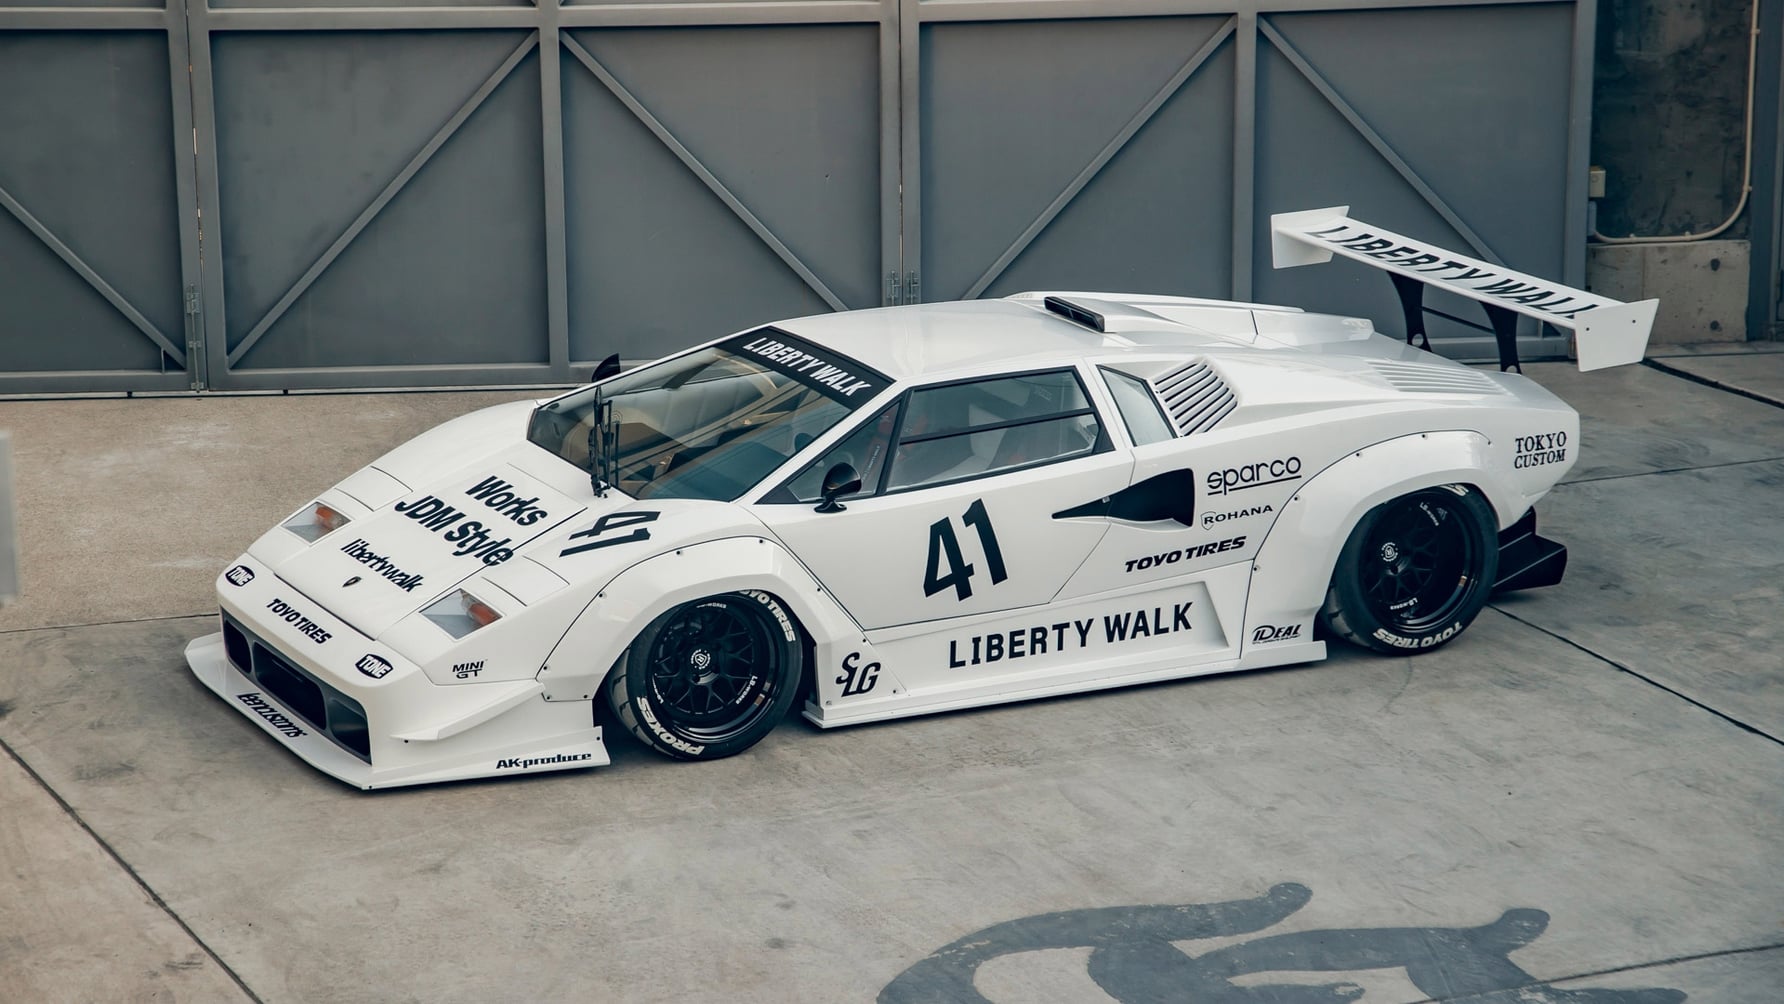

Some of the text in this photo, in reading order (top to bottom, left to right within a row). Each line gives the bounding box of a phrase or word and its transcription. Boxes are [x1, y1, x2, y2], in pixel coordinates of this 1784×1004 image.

[1303, 226, 1497, 280] LIBERTY
[743, 337, 872, 396] LIBERTY WALK
[1514, 449, 1566, 469] CUSTOM
[1515, 431, 1567, 453] TOKYO
[1207, 456, 1302, 495] sparco
[465, 475, 548, 526] Works
[1203, 504, 1273, 525] ROHANA
[394, 495, 514, 566] JDM Style
[558, 511, 661, 558] 41
[923, 498, 1008, 601] 41
[340, 538, 424, 592] libertywalk
[1125, 536, 1247, 573] TOYO TIRES
[227, 566, 253, 586] TONE
[266, 598, 333, 644] TOYO TIRES
[739, 590, 796, 642] YO TIRES
[949, 602, 1193, 669] LIBERTY WALK
[1372, 621, 1463, 648] TOYO TIRES
[358, 655, 391, 678] TONE
[452, 660, 485, 673] MINI
[456, 668, 483, 679] GT
[636, 696, 705, 755] PROXES
[496, 753, 592, 769] AK-produce
